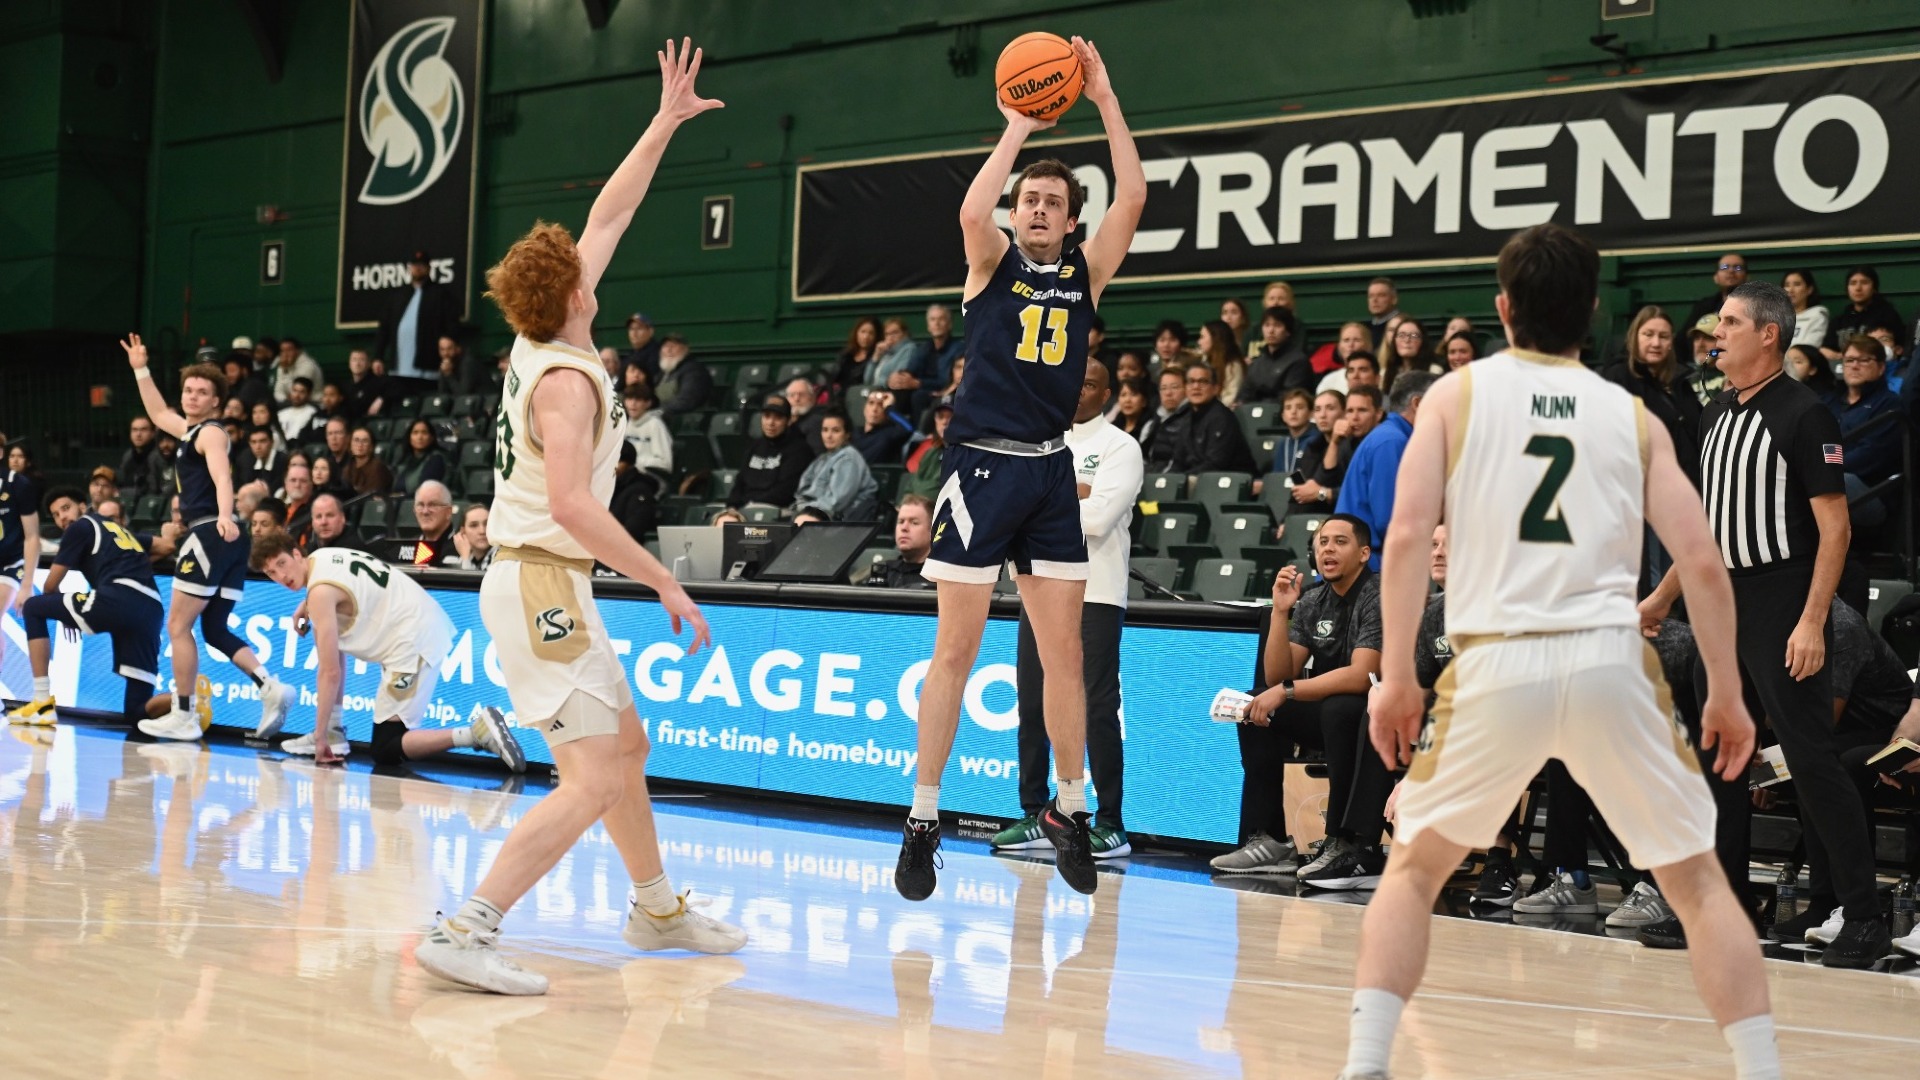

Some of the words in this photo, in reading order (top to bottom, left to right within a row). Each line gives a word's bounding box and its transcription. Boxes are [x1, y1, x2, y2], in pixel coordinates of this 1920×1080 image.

[1007, 71, 1065, 100] Wilson
[1028, 94, 1068, 117] NCAA
[711, 205, 725, 239] 7
[353, 257, 454, 290] HORNTS
[1015, 304, 1069, 366] 13
[1531, 394, 1576, 419] NUNN
[1518, 434, 1576, 545] 2
[228, 681, 261, 704] pat
[441, 629, 1126, 741] MGAGE.CO
[657, 720, 779, 755] first-time
[788, 733, 918, 777] homebuy
[958, 818, 1001, 830] DAKTRONICS
